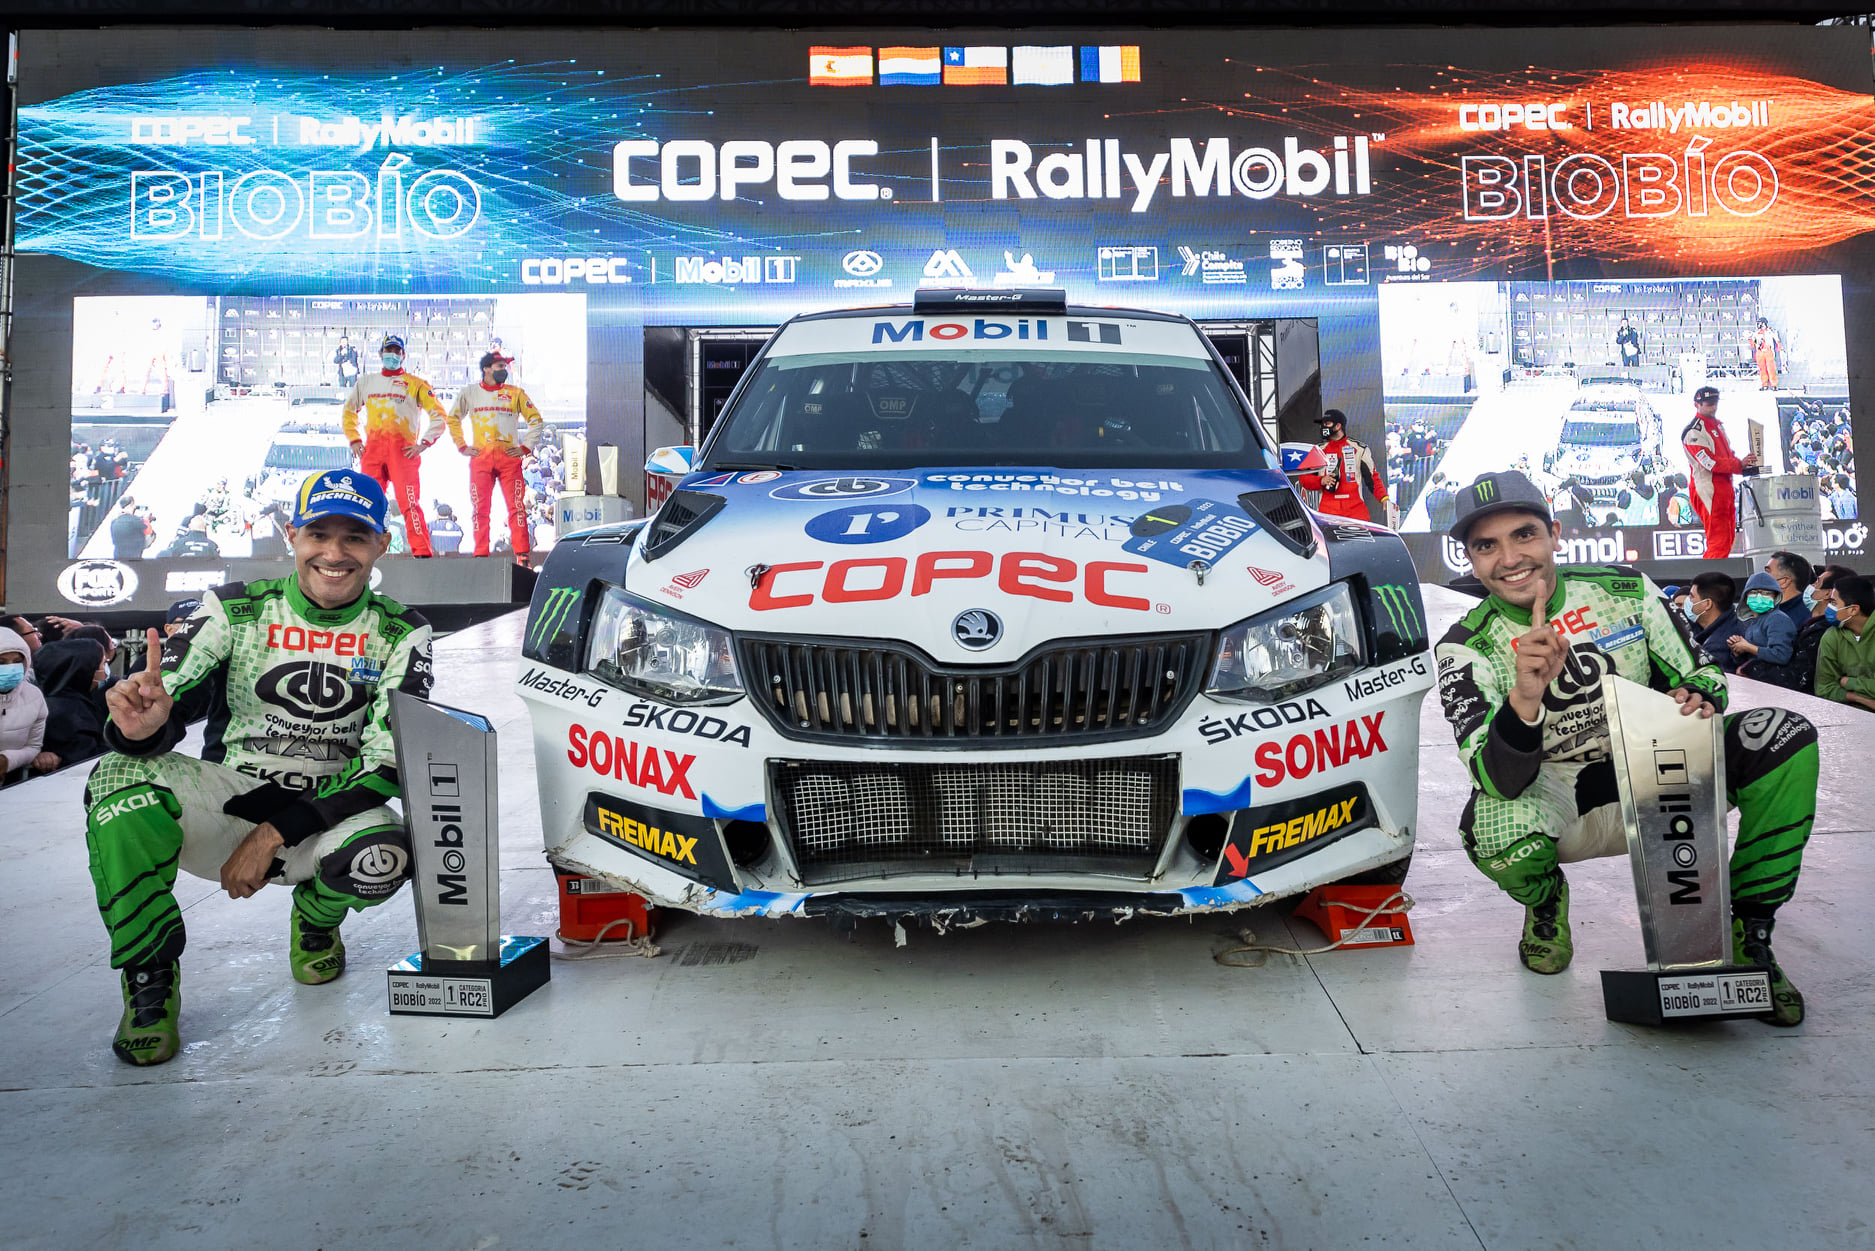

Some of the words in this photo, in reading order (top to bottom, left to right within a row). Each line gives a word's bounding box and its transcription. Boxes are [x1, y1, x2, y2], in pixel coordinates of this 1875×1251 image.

[1611, 100, 1767, 133] RallyMobil
[991, 136, 1371, 212] RallyMobil
[1462, 136, 1779, 221] BIOBÍO
[130, 151, 481, 240] BIOBÍO
[675, 256, 761, 283] Mobil
[872, 318, 1048, 344] Mobil
[879, 398, 907, 410] OMP
[310, 492, 374, 509] MICHELIN
[1777, 487, 1814, 500] Mobil
[946, 506, 1135, 528] PRIMUS
[955, 519, 1122, 541] CAPITAL
[1611, 581, 1638, 590] OMP
[231, 604, 254, 614] OM
[1605, 628, 1644, 649] MICHELIN
[518, 667, 608, 708] Master-G
[1344, 656, 1427, 702] Master-G
[332, 721, 357, 735] belt
[623, 697, 751, 748] ŠKODA
[1198, 698, 1331, 745] ŠKODA
[567, 723, 698, 801] SONAX
[1254, 710, 1389, 788] SONAX
[97, 790, 161, 826] ŠKOD
[597, 806, 698, 865] FREMAX
[1249, 796, 1358, 858] FREMAX
[431, 805, 468, 905] Mobil
[1659, 793, 1702, 905] Mobil
[393, 991, 426, 1006] BIOBÍO
[447, 986, 454, 1002] 1
[459, 992, 482, 1007] RC2
[1723, 982, 1731, 1000] 1
[1737, 987, 1762, 1004] RC2
